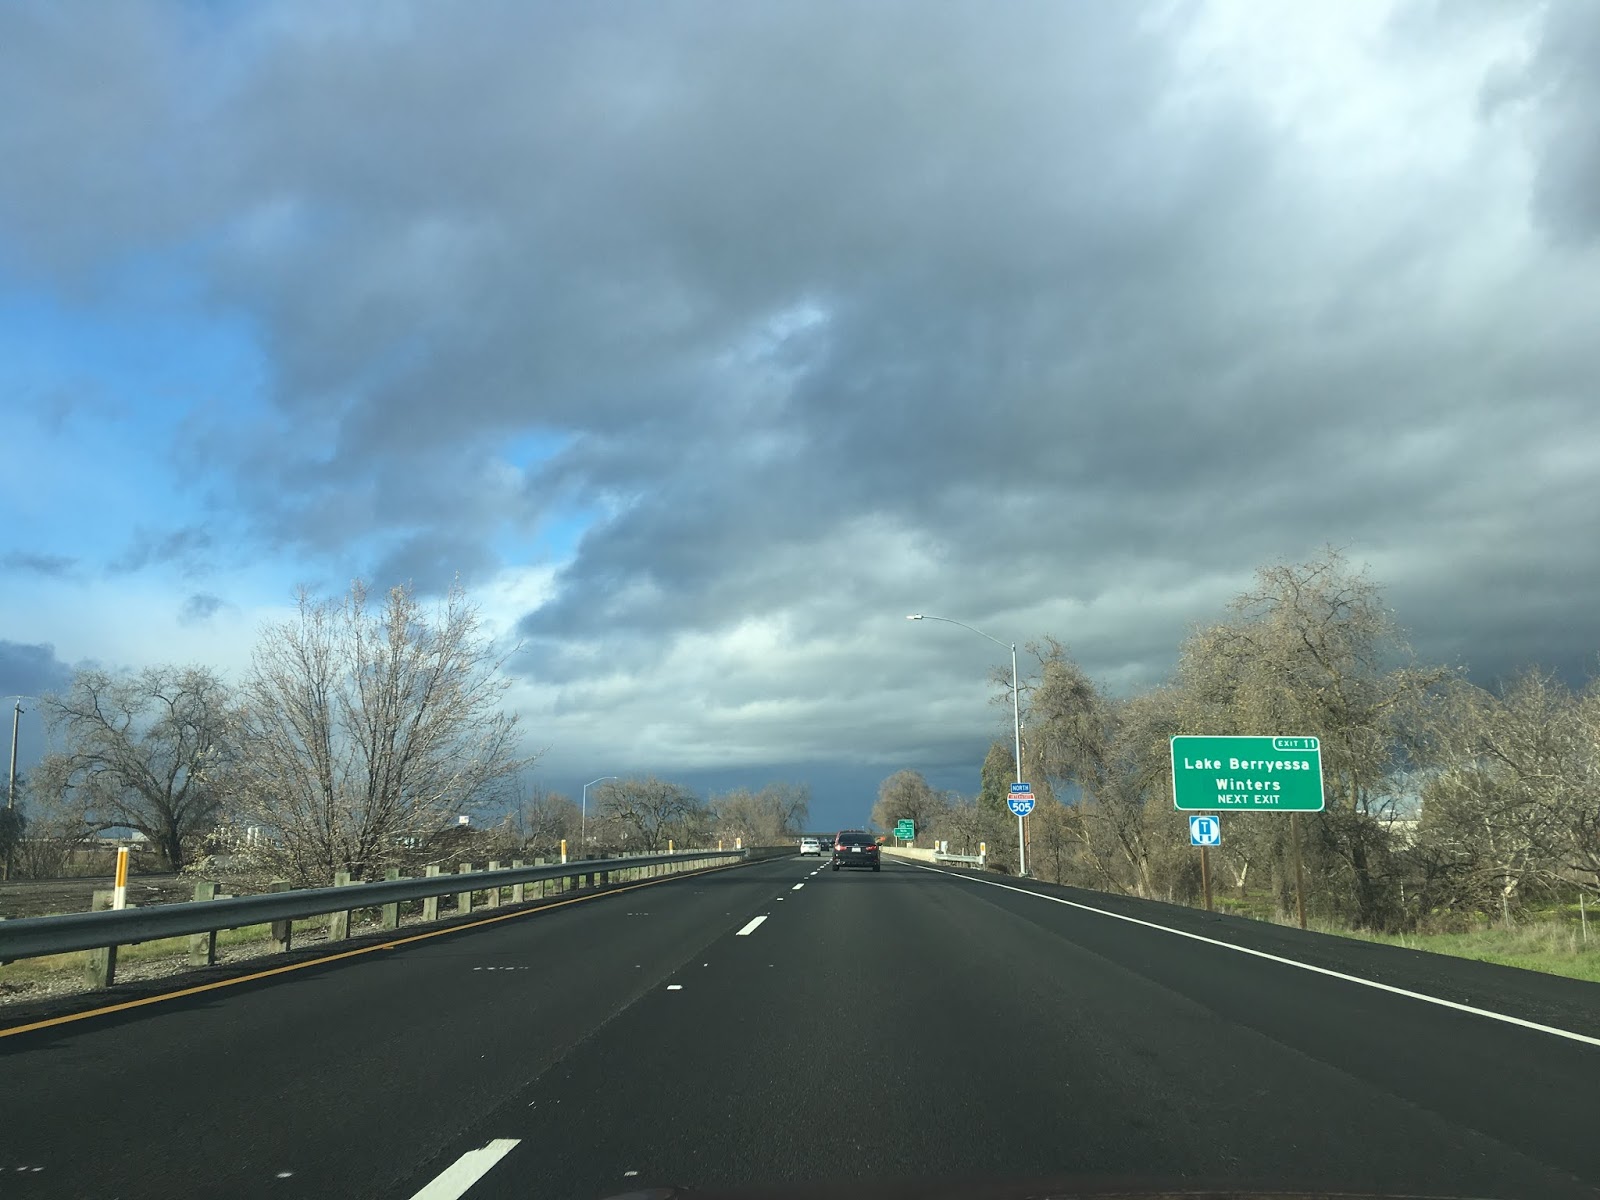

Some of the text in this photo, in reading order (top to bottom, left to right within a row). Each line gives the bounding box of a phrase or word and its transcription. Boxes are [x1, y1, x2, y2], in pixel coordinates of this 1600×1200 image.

[1304, 739, 1315, 748] 11
[1184, 757, 1310, 773] Lake Berryessa
[1216, 778, 1281, 790] Winters
[1217, 794, 1280, 804] NEXT EXIT
[1012, 802, 1032, 812] 505
